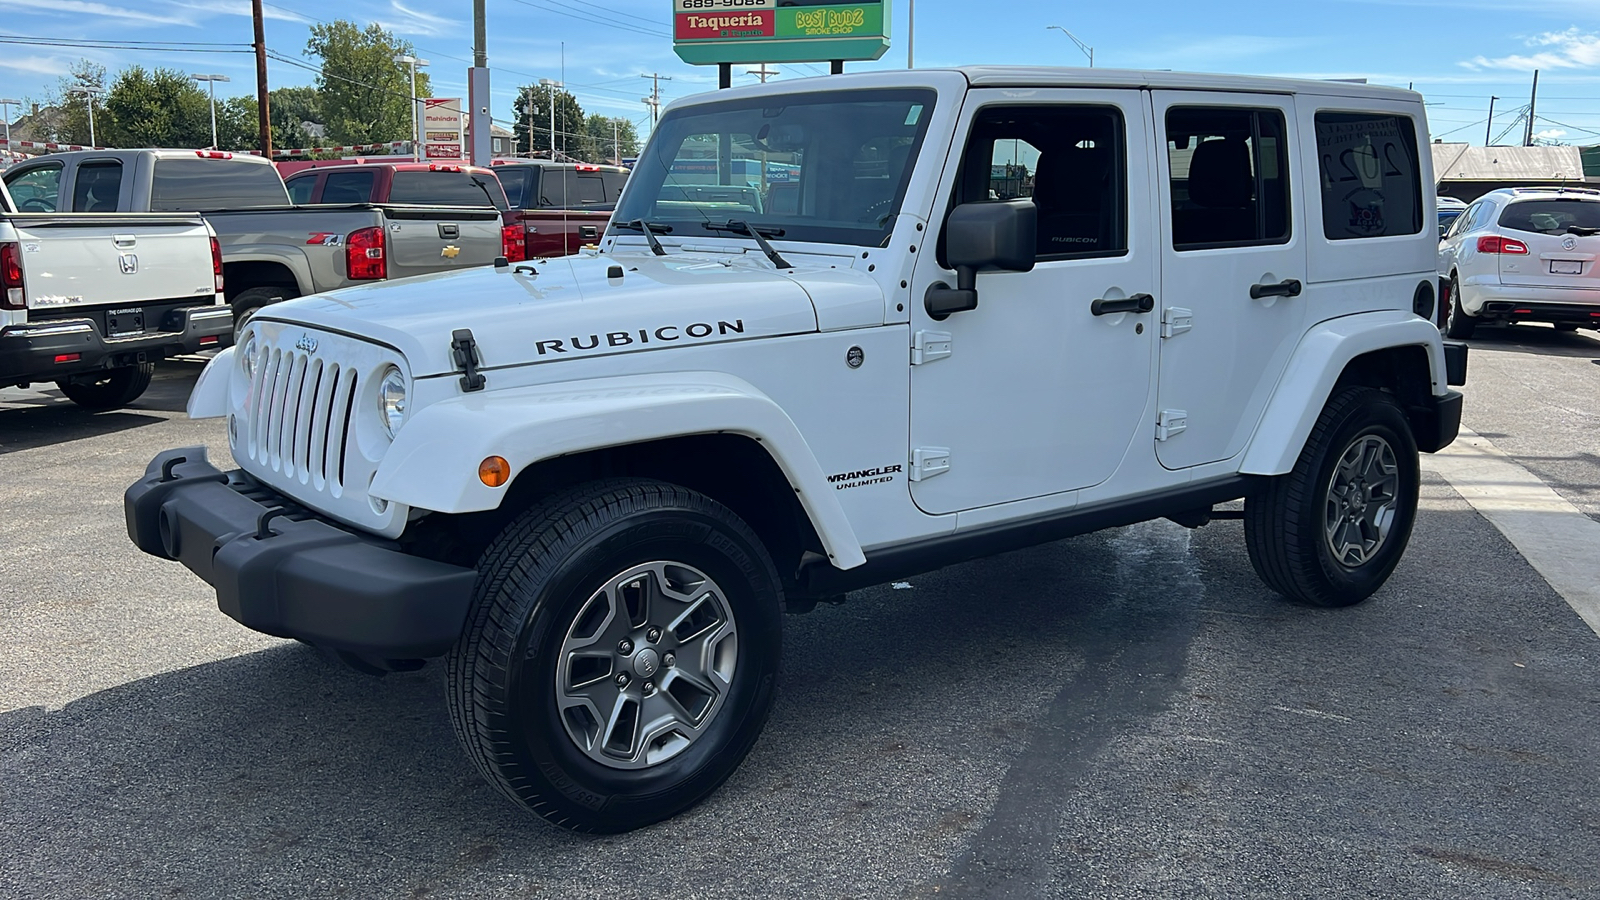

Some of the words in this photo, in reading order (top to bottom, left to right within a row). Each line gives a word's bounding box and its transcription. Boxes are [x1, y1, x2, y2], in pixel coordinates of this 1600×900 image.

[828, 8, 864, 27] BUDZ
[805, 28, 831, 36] SMOKE
[535, 319, 744, 355] RUBICON
[826, 464, 902, 482] WRANGLER
[836, 475, 893, 490] UNLIMITED
